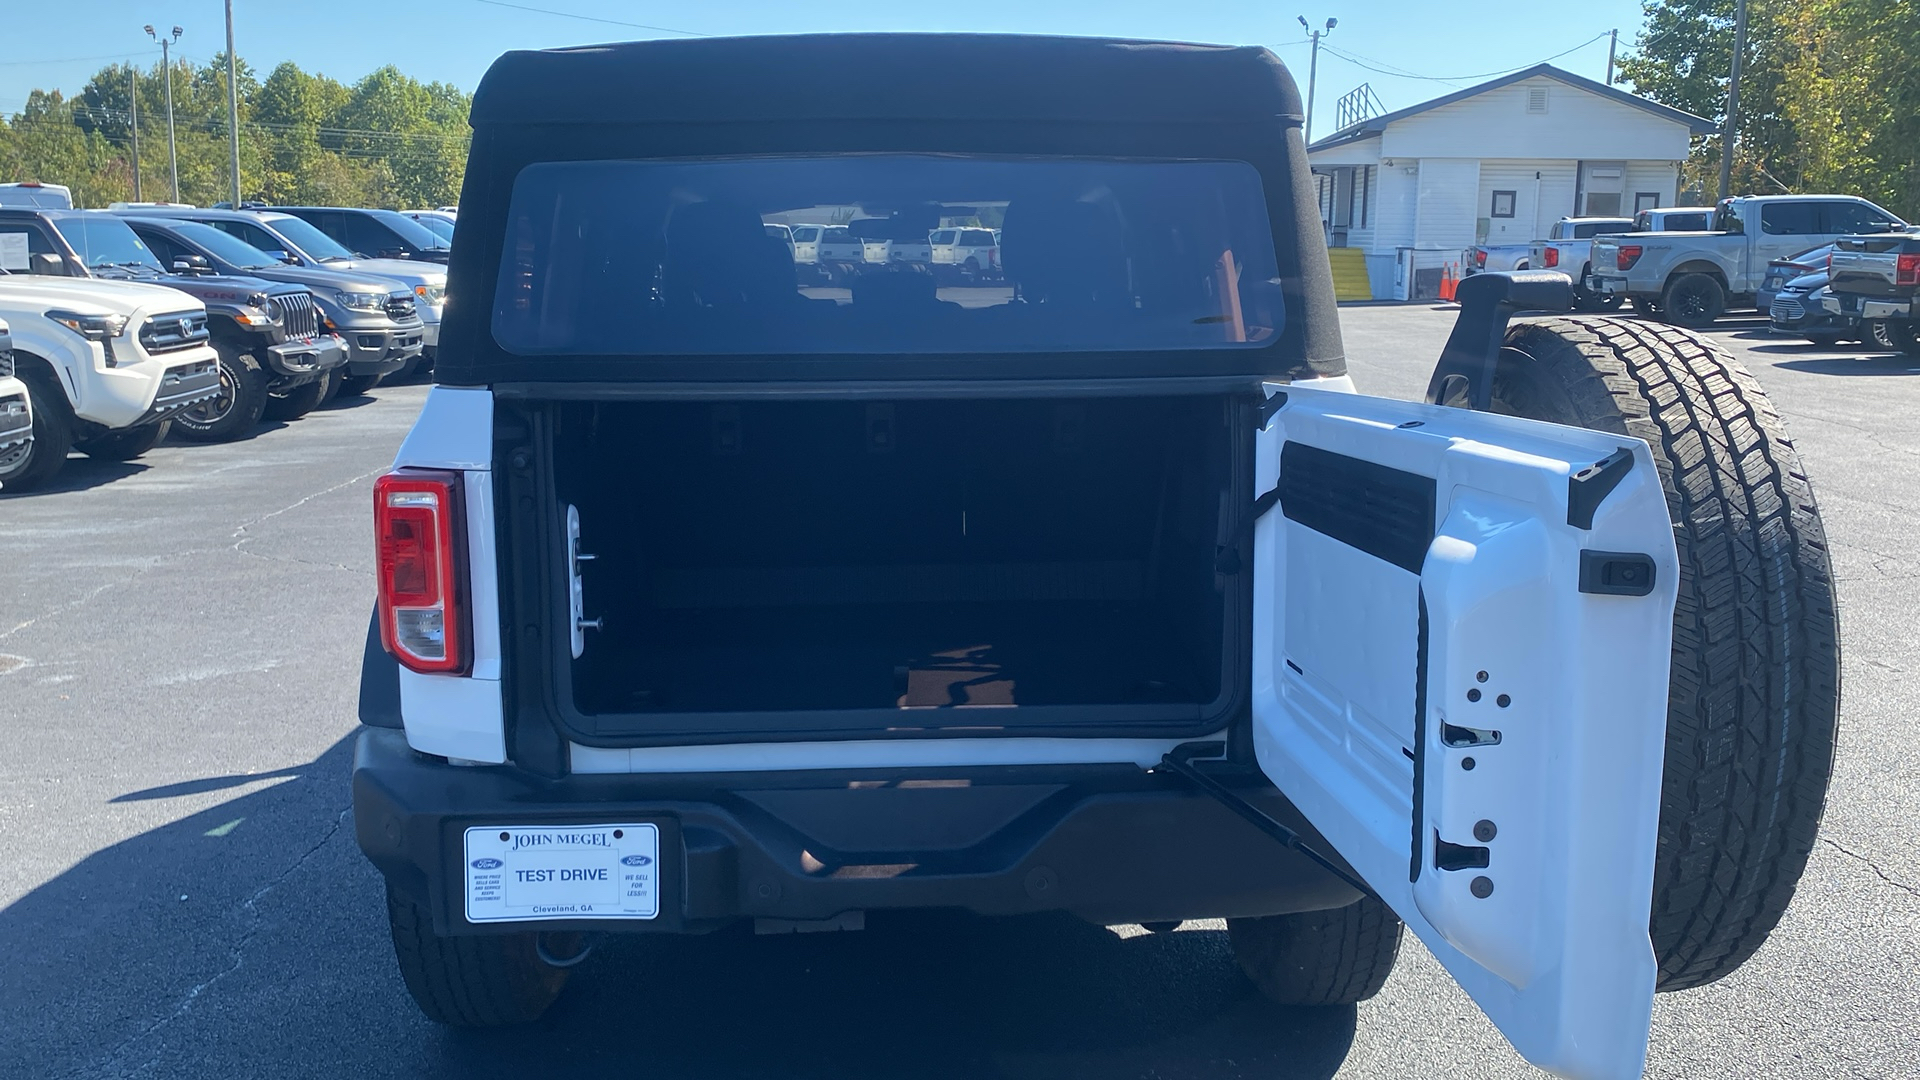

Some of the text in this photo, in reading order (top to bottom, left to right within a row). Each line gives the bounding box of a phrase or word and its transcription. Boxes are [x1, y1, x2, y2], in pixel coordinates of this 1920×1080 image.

[512, 833, 611, 851] JOHN MEGEL
[515, 868, 608, 882] TEST DRIVE
[532, 904, 593, 913] Cleveland, GA
